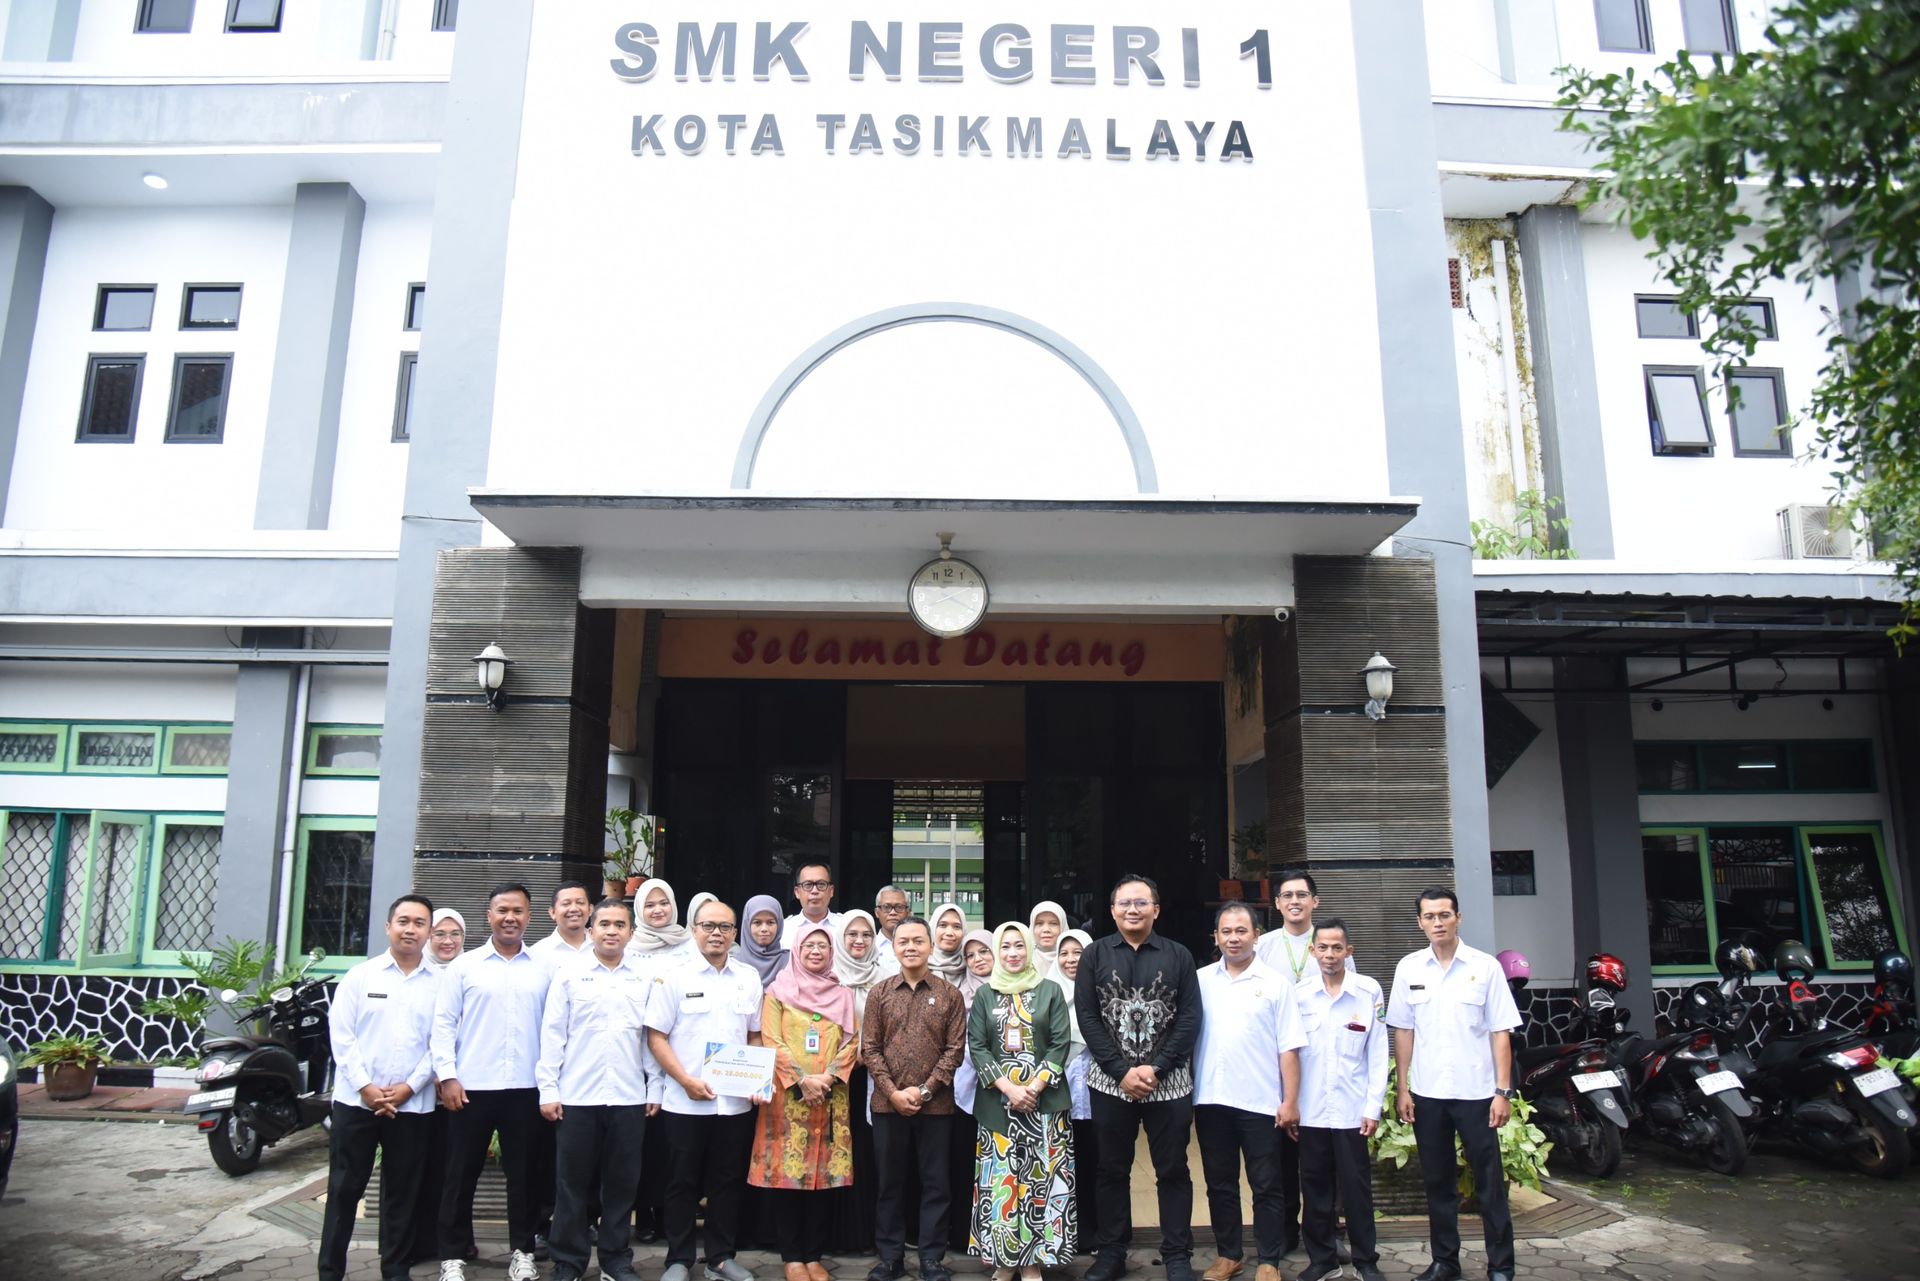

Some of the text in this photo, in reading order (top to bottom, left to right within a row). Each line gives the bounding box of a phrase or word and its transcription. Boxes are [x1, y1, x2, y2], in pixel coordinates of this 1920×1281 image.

[610, 20, 1273, 89] SMK NEGERI 1
[631, 113, 1254, 162] KOTA TASIKMALAYA
[932, 572, 939, 580] 11
[944, 568, 953, 577] 12
[732, 630, 1145, 677] Selamat Datang
